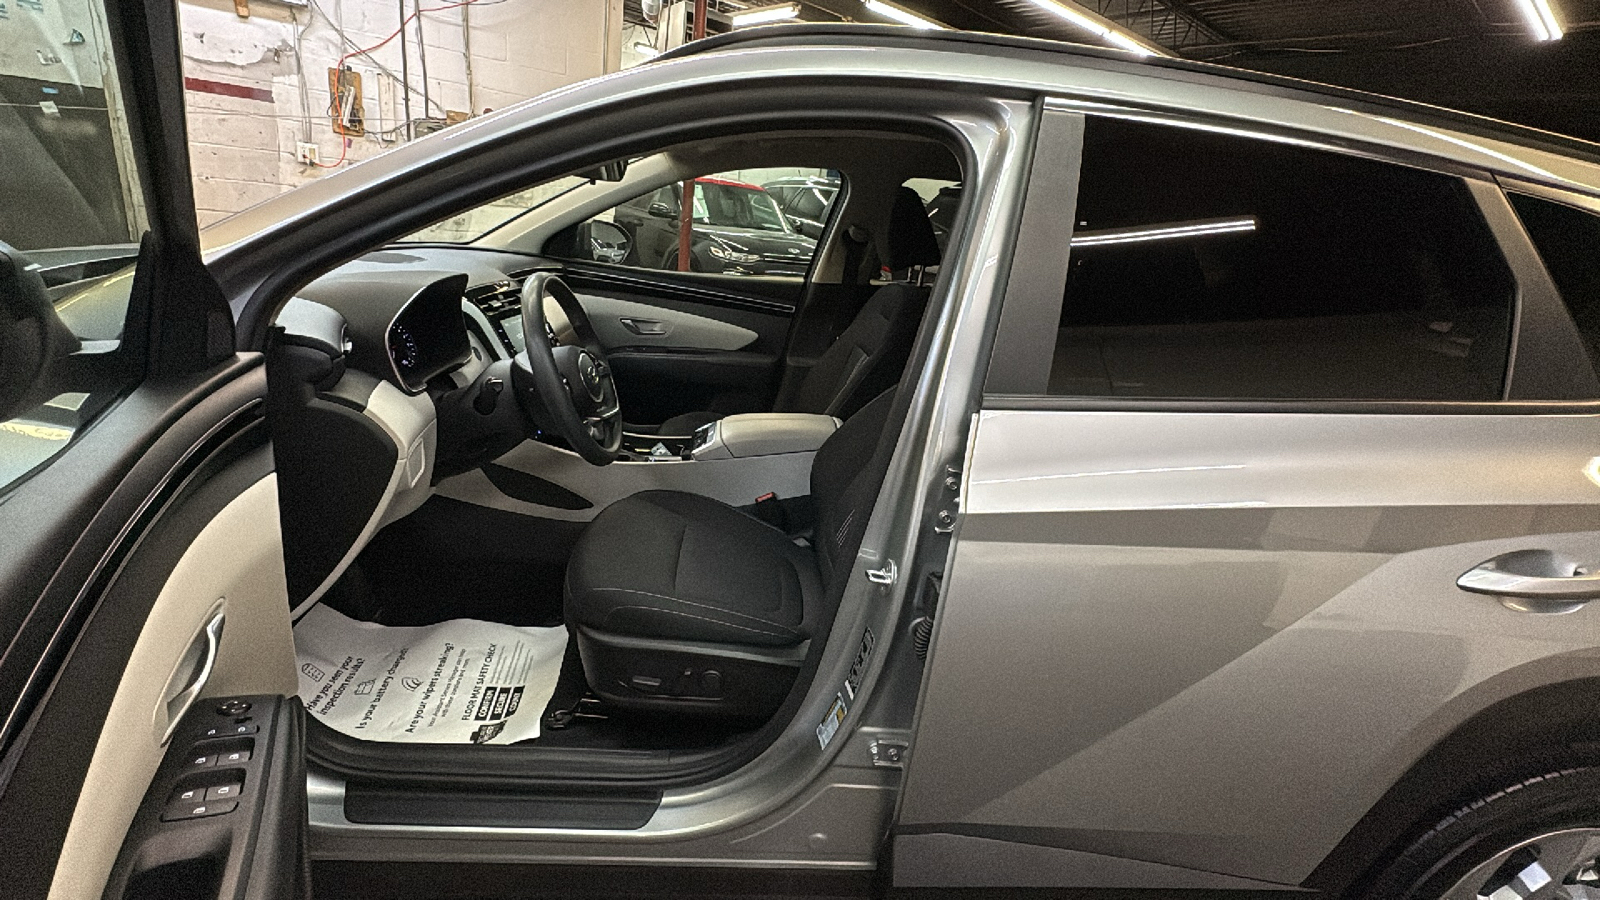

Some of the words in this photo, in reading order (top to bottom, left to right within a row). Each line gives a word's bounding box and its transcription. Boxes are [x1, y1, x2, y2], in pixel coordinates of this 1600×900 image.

[306, 694, 324, 710] Have
[320, 682, 332, 697] you
[329, 669, 344, 684] seen
[317, 682, 349, 716] inspection
[344, 658, 366, 683] results?
[362, 704, 378, 721] your
[370, 675, 394, 704] battery
[405, 720, 418, 734] Are
[413, 701, 428, 719] your
[422, 678, 439, 700] wipers
[434, 642, 454, 678] streaking?
[462, 699, 478, 720] FLOOR
[470, 684, 482, 699] MAT
[476, 663, 491, 685] SAFETY
[484, 643, 497, 664] CHECK
